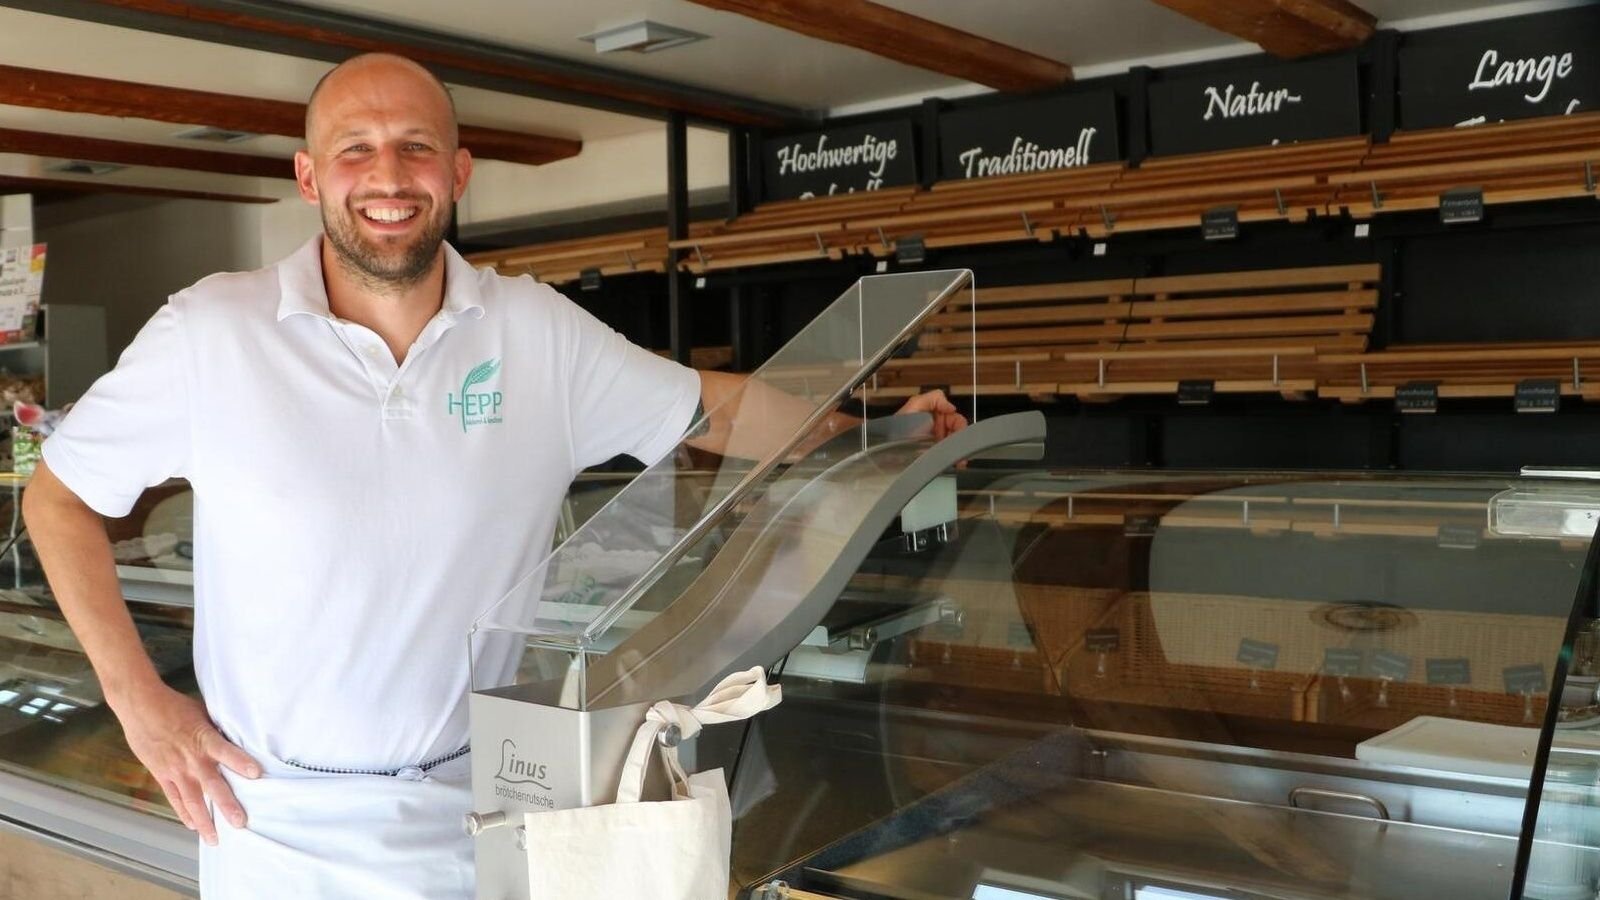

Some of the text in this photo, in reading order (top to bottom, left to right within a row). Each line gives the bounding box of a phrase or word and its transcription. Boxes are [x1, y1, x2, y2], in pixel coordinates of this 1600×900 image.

[1468, 49, 1573, 103] Lange
[1203, 81, 1303, 121] Natur-
[776, 134, 898, 178] Hochwertige
[959, 127, 1097, 179] Traditionell
[447, 386, 503, 432] HEPP
[493, 738, 552, 791] Linus
